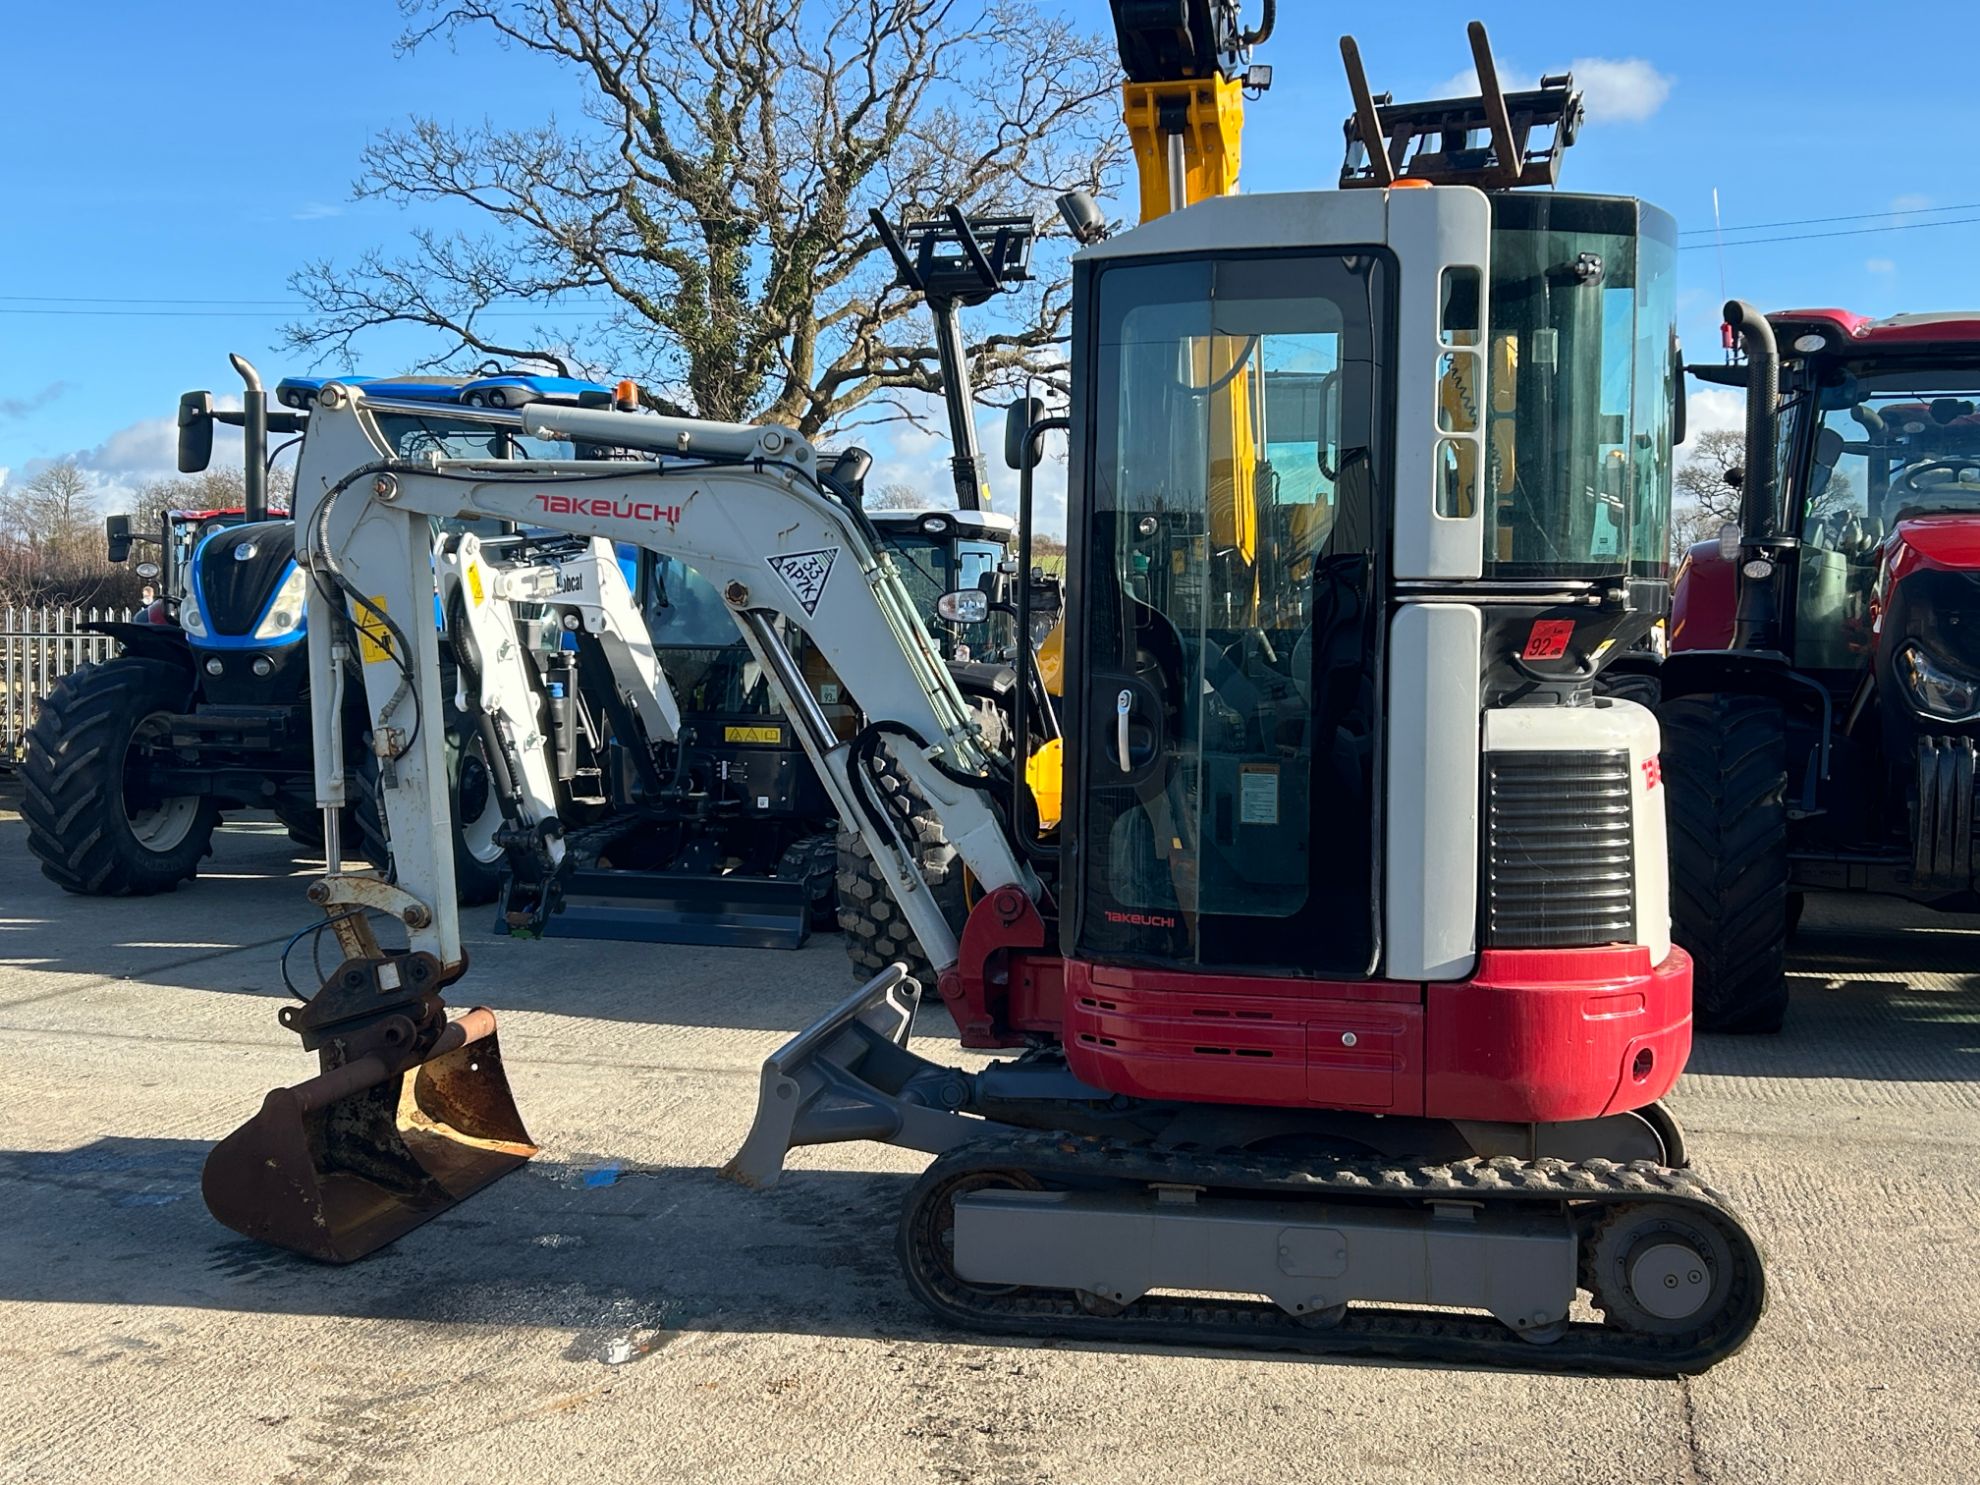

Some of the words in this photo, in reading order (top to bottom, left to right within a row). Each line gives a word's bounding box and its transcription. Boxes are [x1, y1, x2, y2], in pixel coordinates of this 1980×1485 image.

[536, 494, 681, 523] TAKEUCHI
[803, 556, 824, 579] 33
[783, 561, 818, 599] AP7K
[1529, 638, 1552, 656] 92
[1105, 911, 1175, 928] TAKEUCHI
